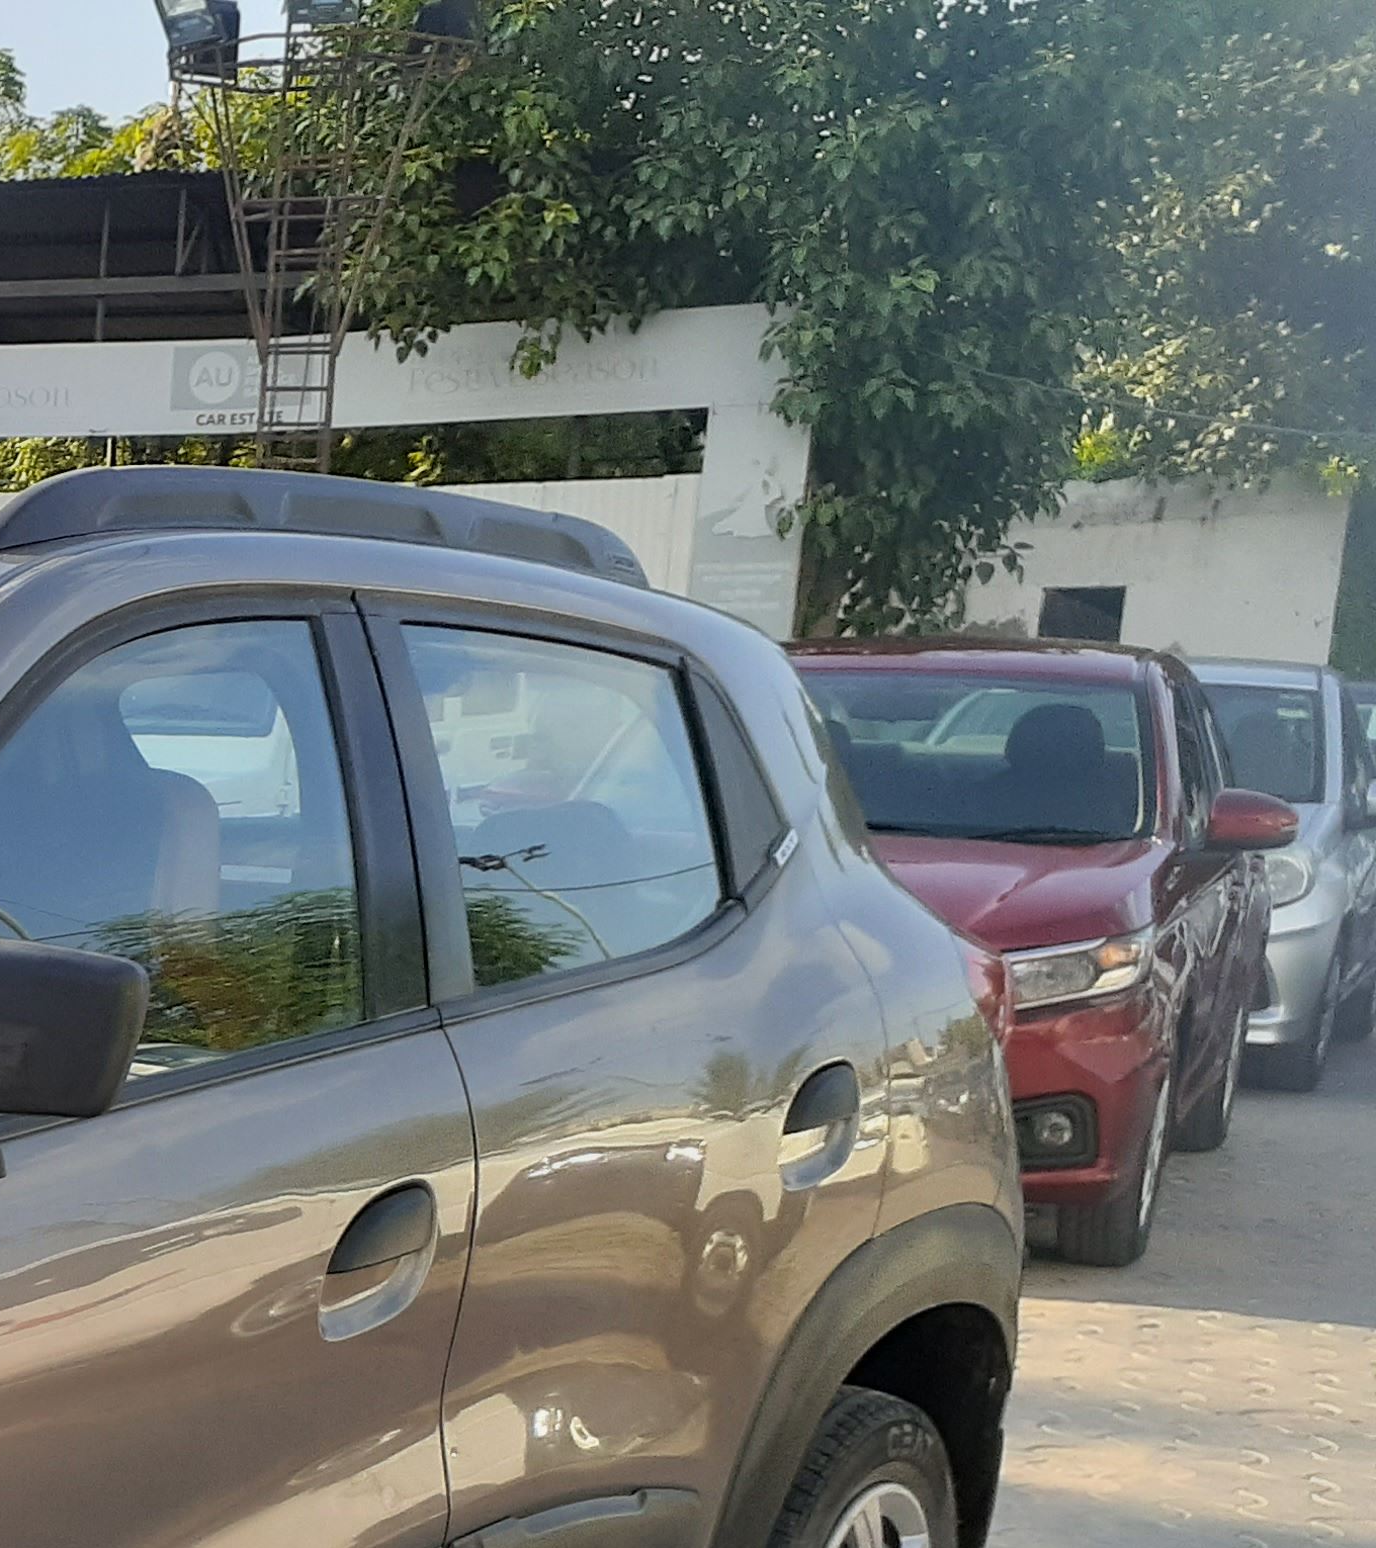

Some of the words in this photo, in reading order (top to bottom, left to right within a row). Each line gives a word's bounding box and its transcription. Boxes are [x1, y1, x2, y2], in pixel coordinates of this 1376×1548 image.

[193, 367, 233, 388] AU
[196, 414, 227, 426] CAR
[230, 411, 284, 425] ESTTE
